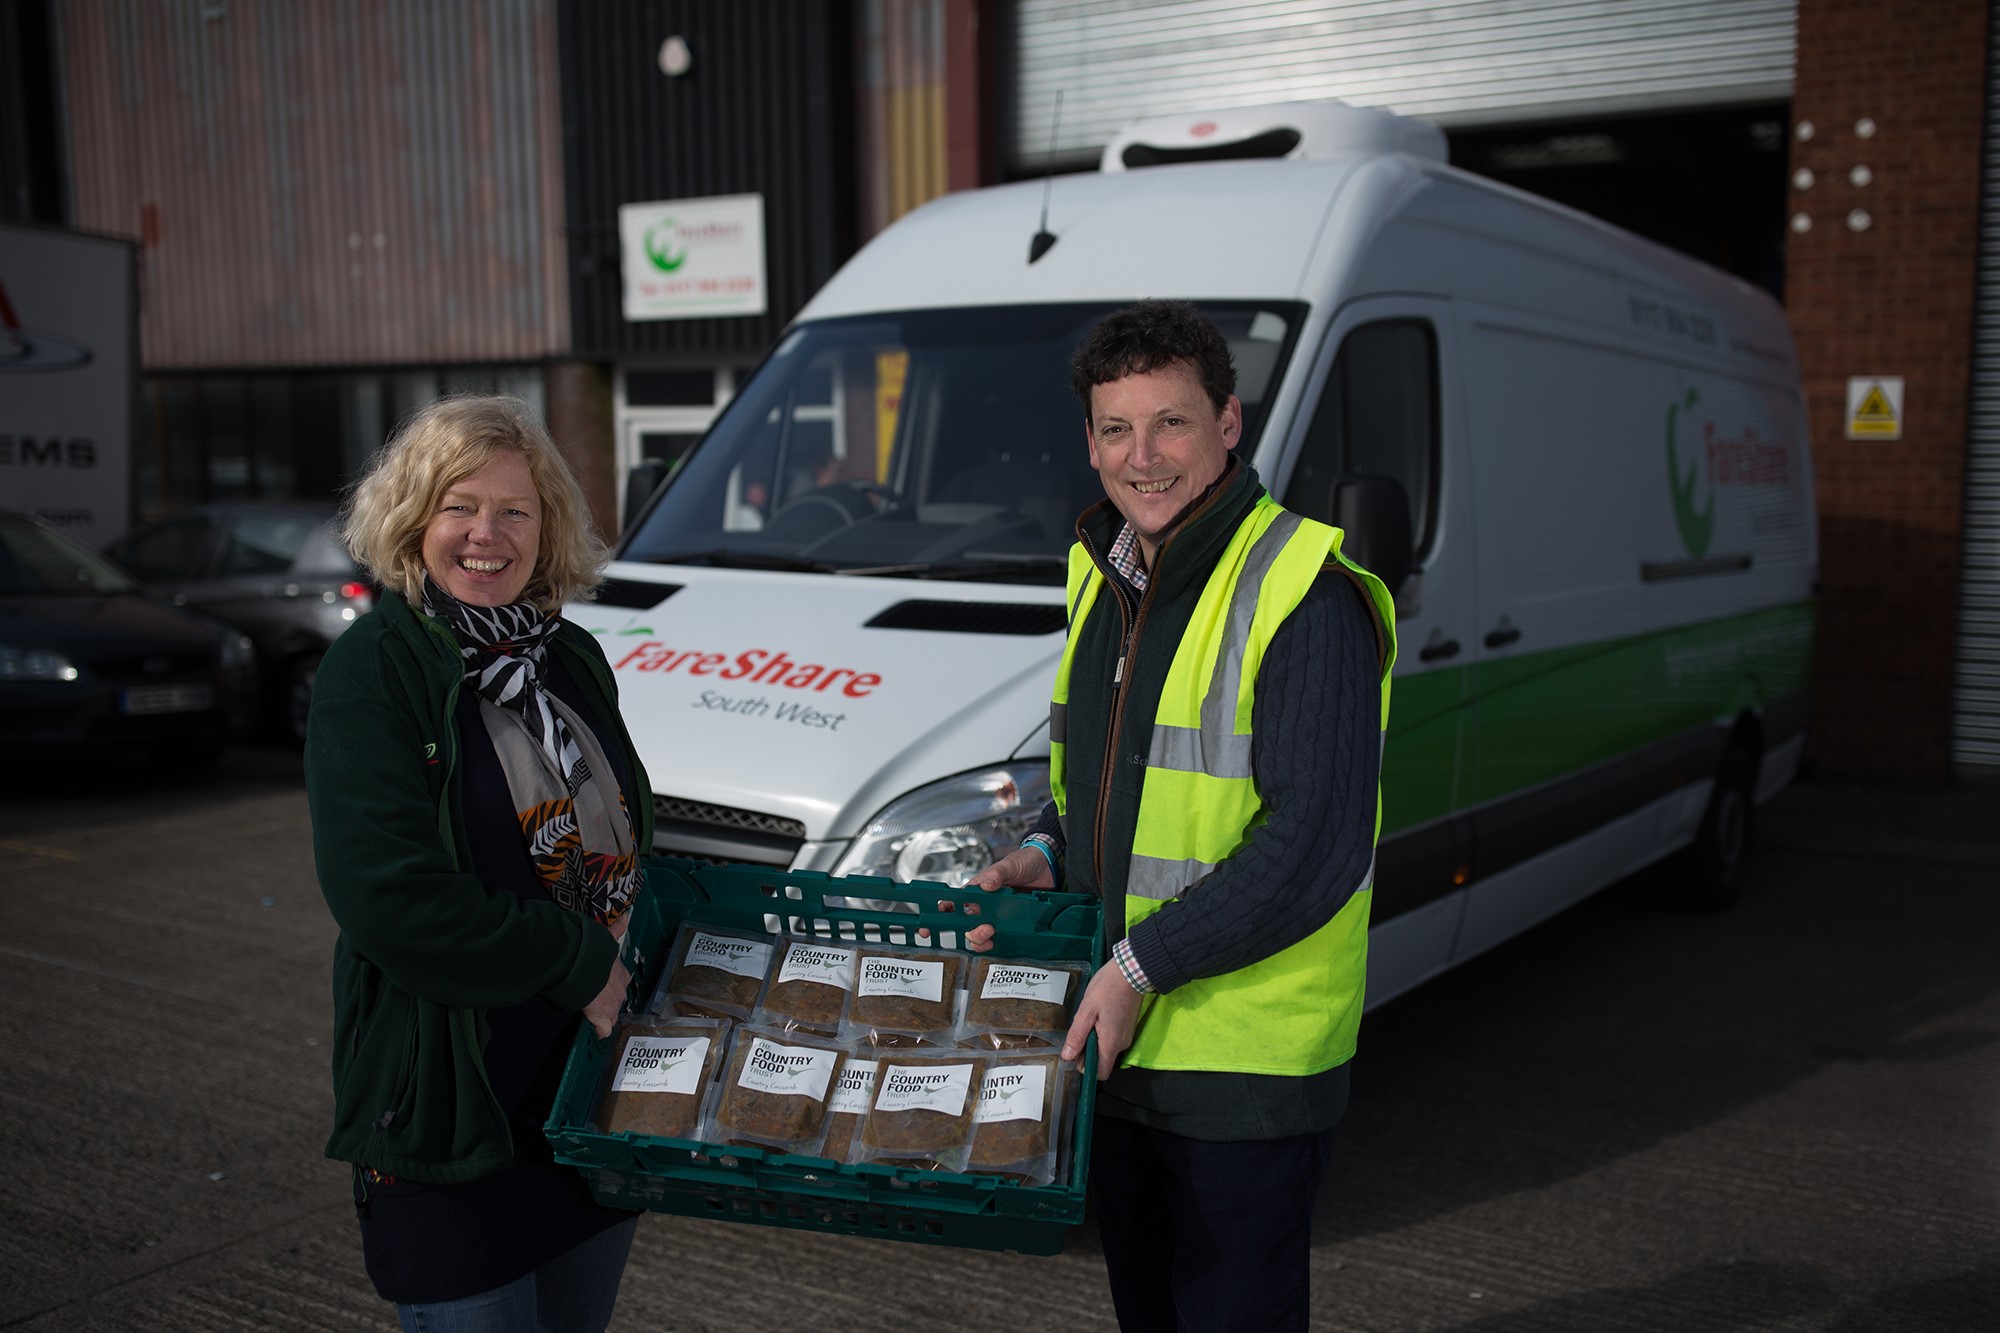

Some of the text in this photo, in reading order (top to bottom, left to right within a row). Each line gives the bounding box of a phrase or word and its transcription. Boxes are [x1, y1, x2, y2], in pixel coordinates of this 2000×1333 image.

[614, 641, 883, 699] FareShare
[692, 689, 848, 732] South West
[695, 944, 726, 956] FOOD
[698, 938, 753, 953] COUNTRY
[789, 956, 821, 966] FOOD
[792, 949, 848, 962] COUNTRY
[785, 970, 806, 978] Country
[866, 963, 923, 976] COUNTRY
[992, 970, 1049, 980] COUNTRY
[865, 971, 898, 980] FOOD
[990, 976, 1022, 984] FOOD
[864, 986, 887, 994] Country
[758, 1041, 772, 1050] THE
[629, 1047, 687, 1059] COUNTRY
[755, 1047, 813, 1065] COUNTRY
[625, 1057, 659, 1069] FOOD
[751, 1057, 785, 1074] FOOD
[749, 1067, 774, 1078] TRUST
[619, 1078, 641, 1089] Country
[746, 1076, 768, 1090] Country
[890, 1074, 950, 1085] COUNTRY
[887, 1083, 921, 1093] FOOD
[883, 1100, 906, 1108] Country
